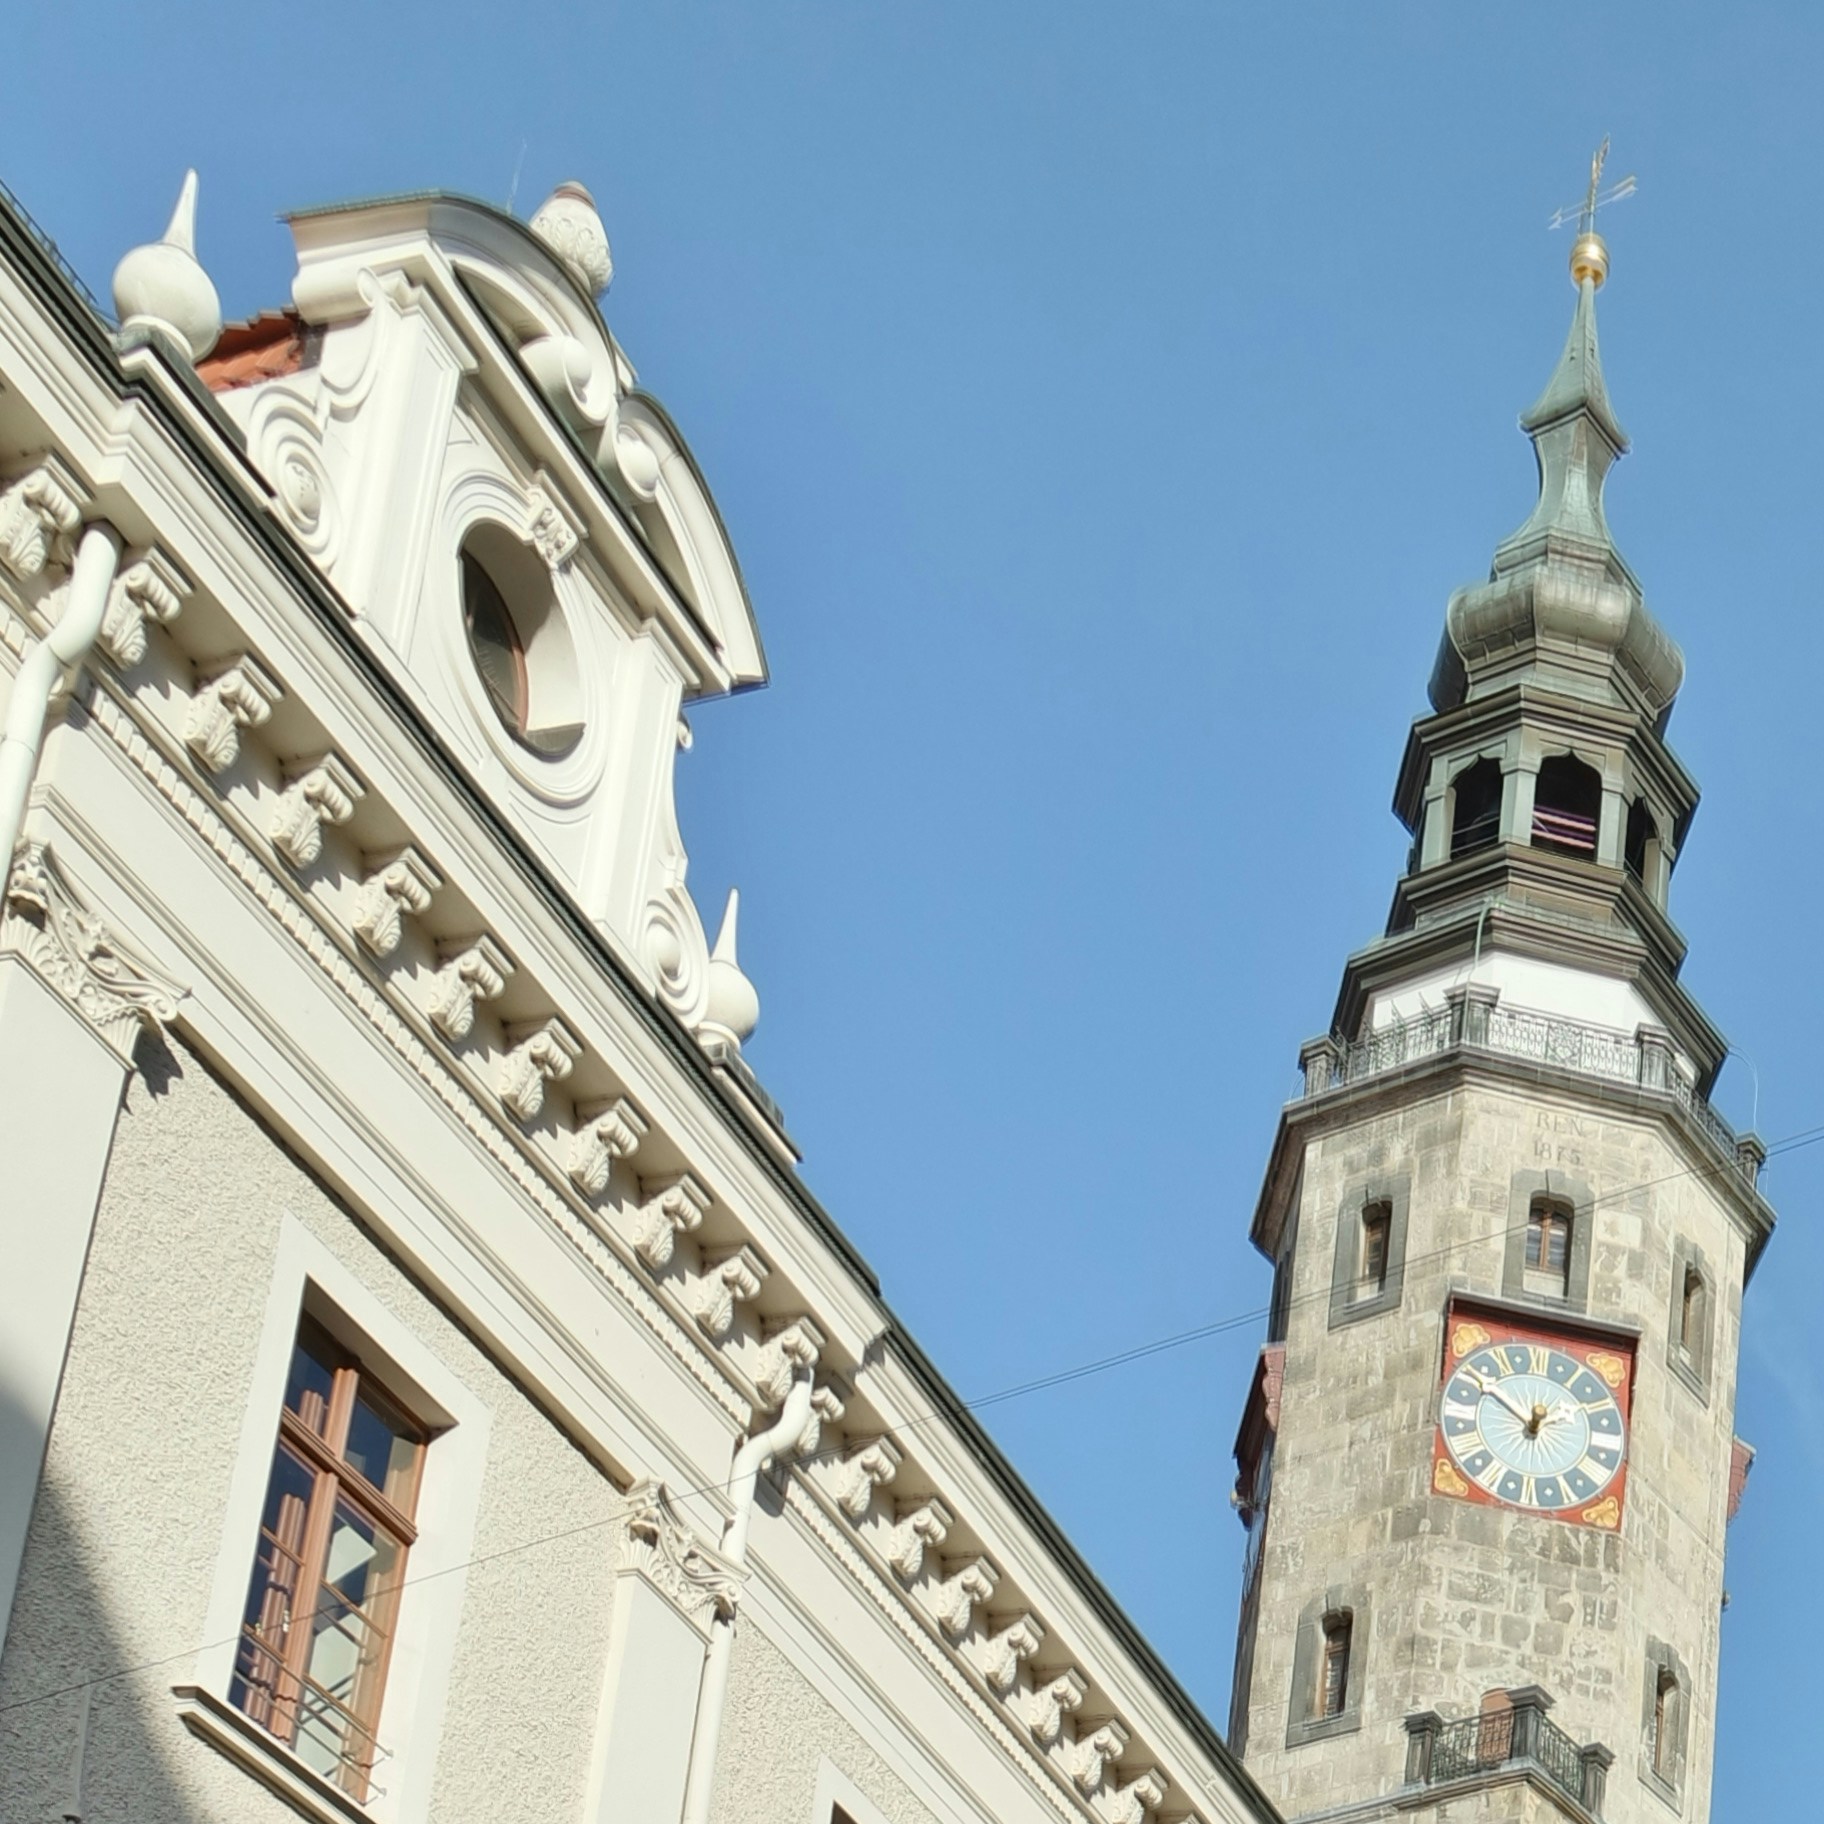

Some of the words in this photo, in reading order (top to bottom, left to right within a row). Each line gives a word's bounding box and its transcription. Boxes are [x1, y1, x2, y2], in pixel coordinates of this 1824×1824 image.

[1527, 1347, 1550, 1376] XII
[1564, 1365, 1586, 1389] I
[1556, 1474, 1580, 1504] V
